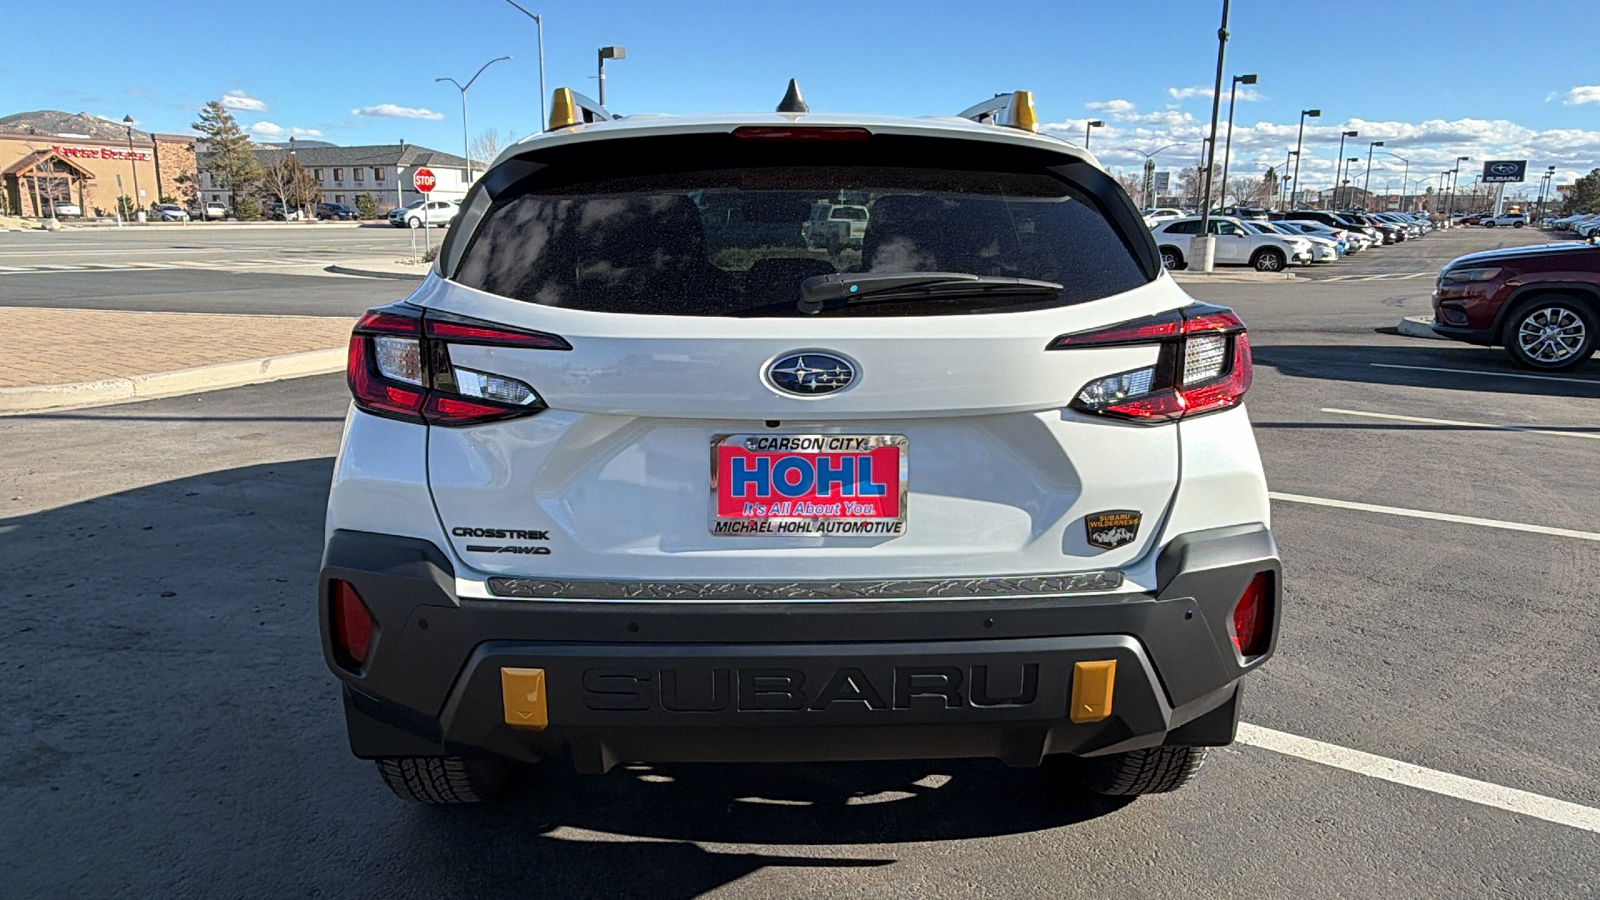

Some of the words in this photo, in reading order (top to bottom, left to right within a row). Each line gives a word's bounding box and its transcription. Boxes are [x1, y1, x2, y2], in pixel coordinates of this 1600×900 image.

[416, 175, 435, 186] STOP
[757, 437, 824, 450] CARSON
[828, 437, 864, 450] CITY
[730, 455, 887, 498] HOHL
[742, 502, 765, 516] It's
[768, 502, 790, 515] All
[793, 501, 841, 515] About
[845, 500, 876, 515] You.
[714, 521, 773, 534] MICHAEL
[777, 521, 813, 533] HOHL
[816, 521, 902, 533] AUTOMOTIVE
[1090, 518, 1139, 528] WILDERNESS
[451, 526, 551, 541] CROSSTREK
[497, 545, 551, 555] AWD
[581, 662, 1040, 713] SUBARU
